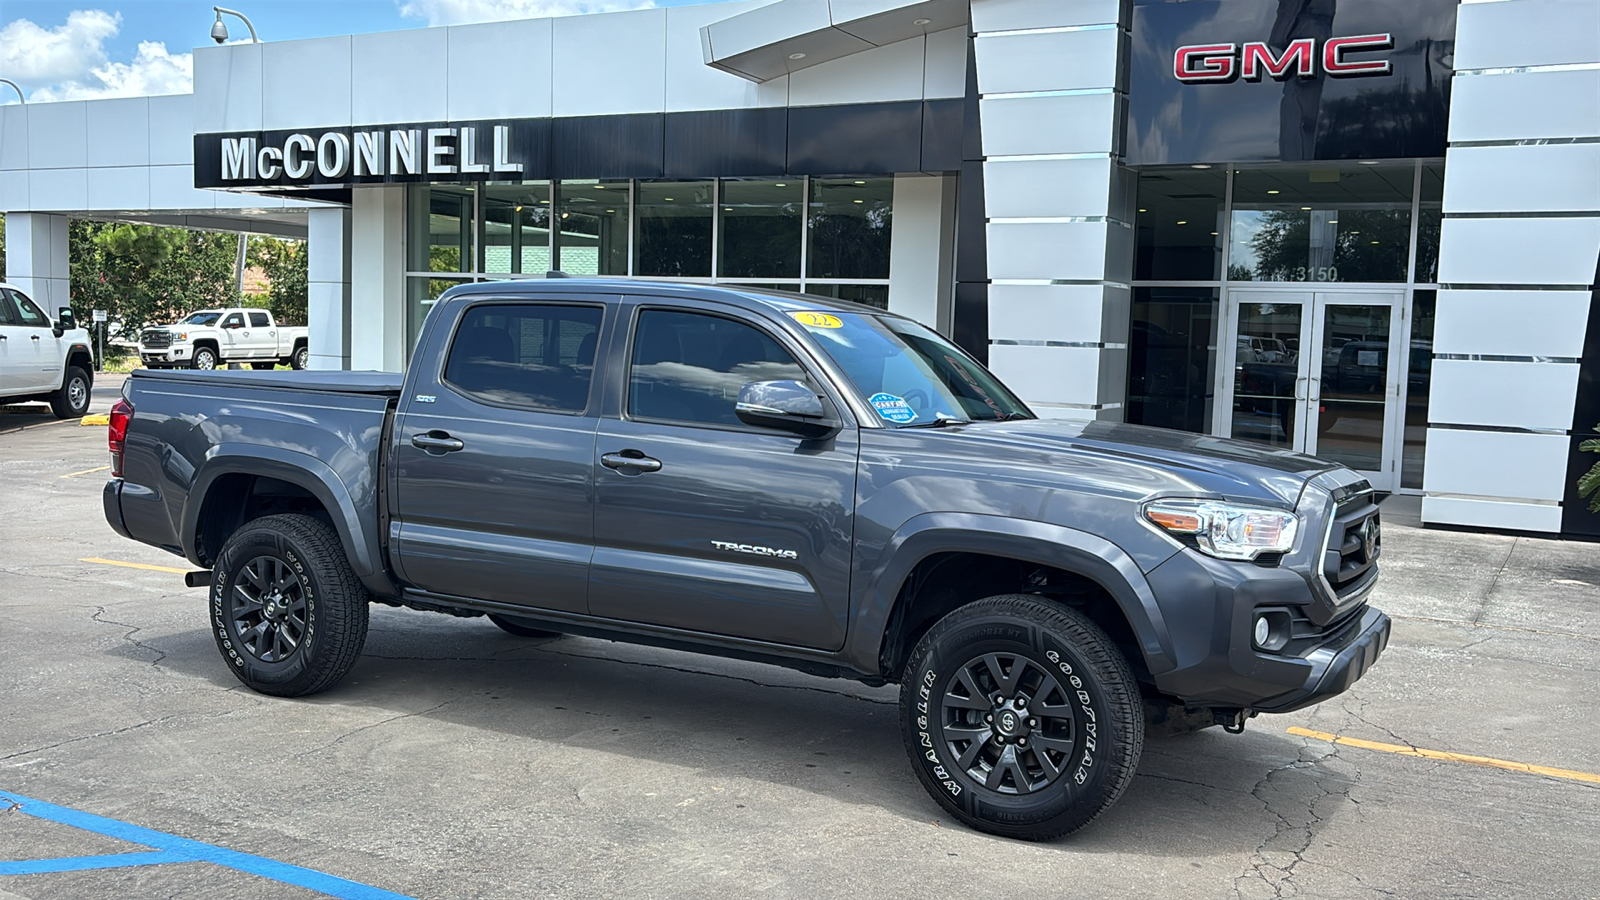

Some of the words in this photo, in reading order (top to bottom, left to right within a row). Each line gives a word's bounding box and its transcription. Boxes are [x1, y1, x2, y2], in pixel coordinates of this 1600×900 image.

[1174, 33, 1394, 82] GMC
[220, 125, 524, 181] McCONNELL
[1296, 266, 1338, 282] 3150
[806, 313, 832, 326] 22
[710, 540, 798, 559] TACOMA
[214, 570, 244, 667] GOODYEAR
[286, 550, 317, 648] WRANGLER
[917, 669, 962, 796] WRANGLER
[1045, 650, 1098, 785] GOODYEAR
